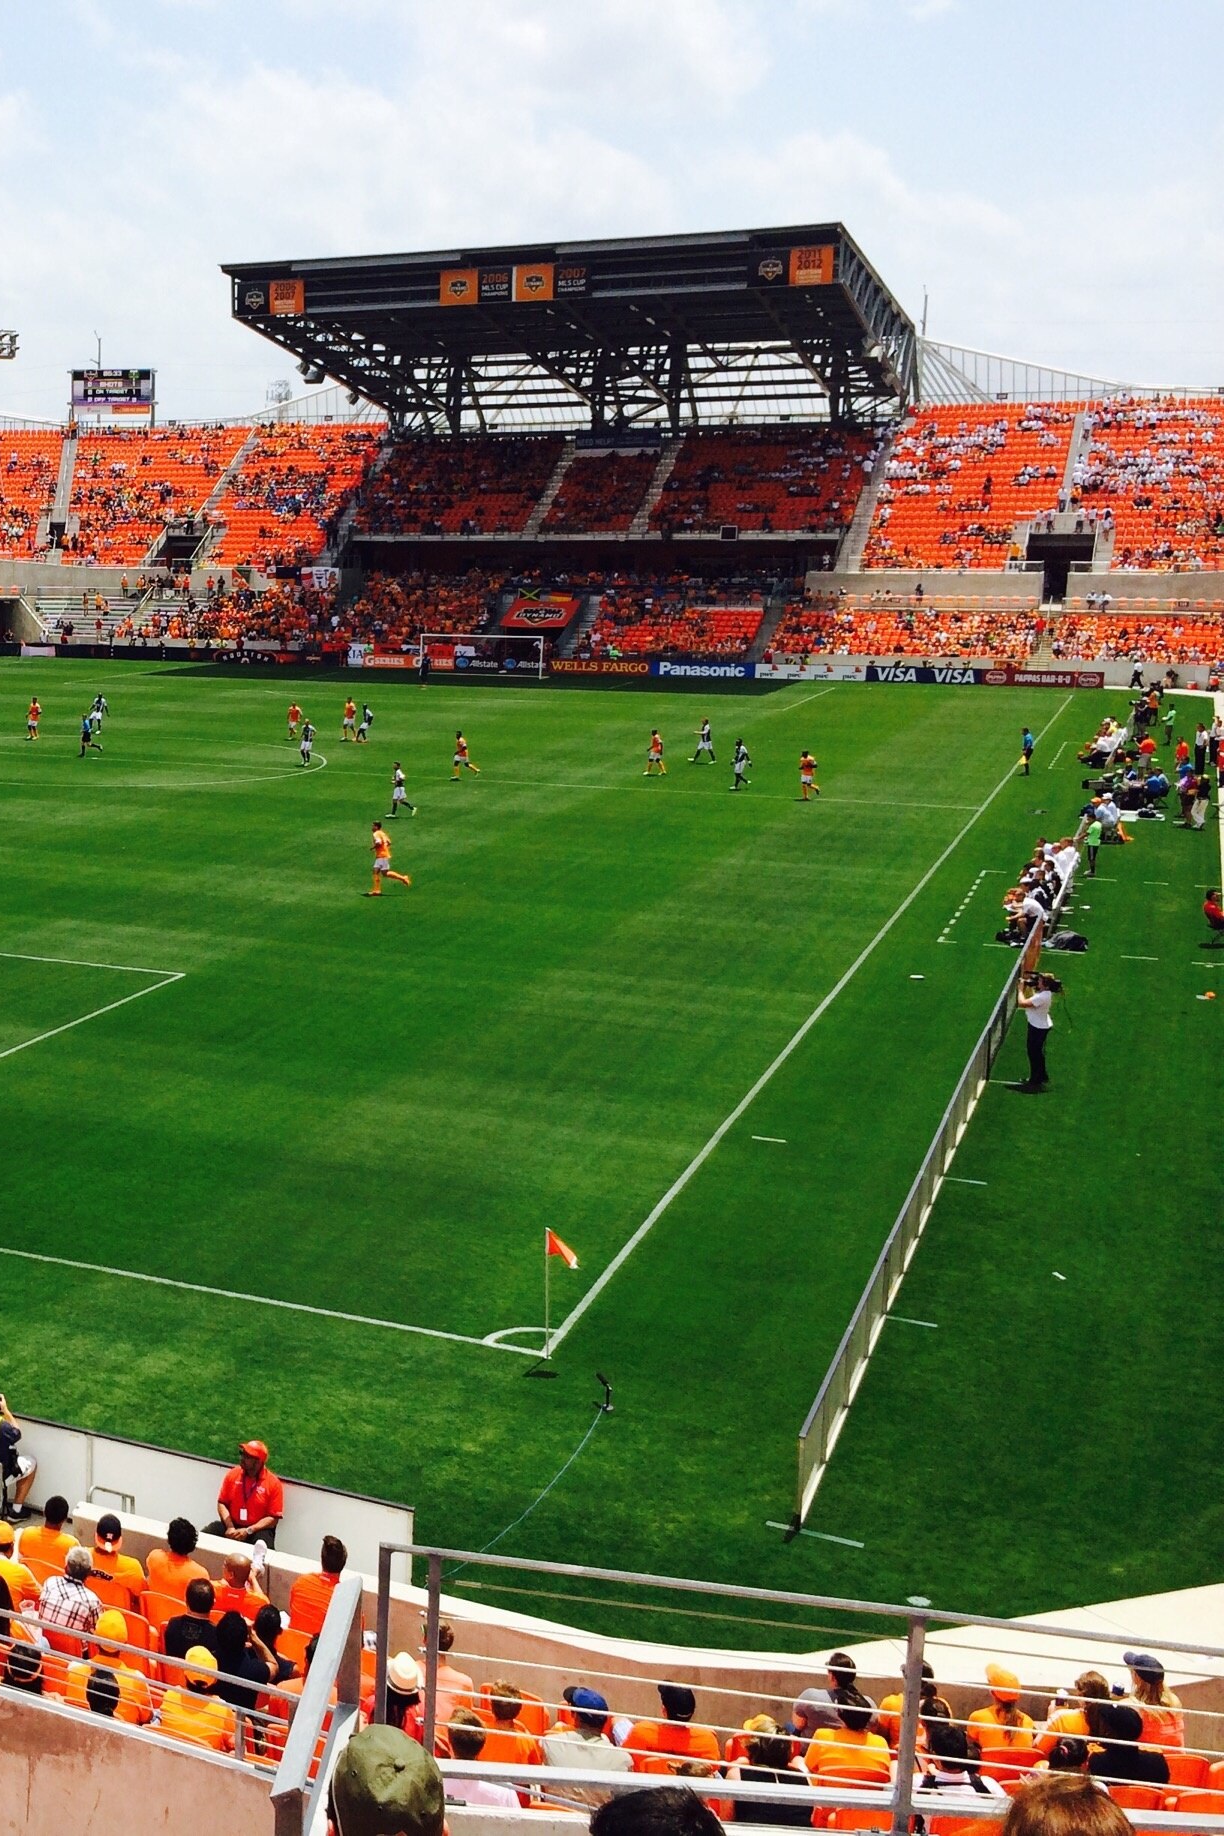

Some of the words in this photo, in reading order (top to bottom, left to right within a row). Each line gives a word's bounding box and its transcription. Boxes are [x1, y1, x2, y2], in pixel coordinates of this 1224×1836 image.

[797, 249, 822, 259] 2011
[797, 259, 823, 270] 2012
[482, 272, 509, 283] 2006
[559, 268, 586, 279] 2007
[274, 292, 296, 300] 2007
[222, 651, 269, 662] HOUSTON
[469, 659, 499, 668] Allstate
[551, 661, 598, 672] WELLS
[601, 661, 649, 673] FARGO
[659, 661, 746, 677] Panasonic
[876, 667, 917, 682] VISA
[932, 668, 975, 684] VISA
[1014, 673, 1041, 682] PAPPAS
